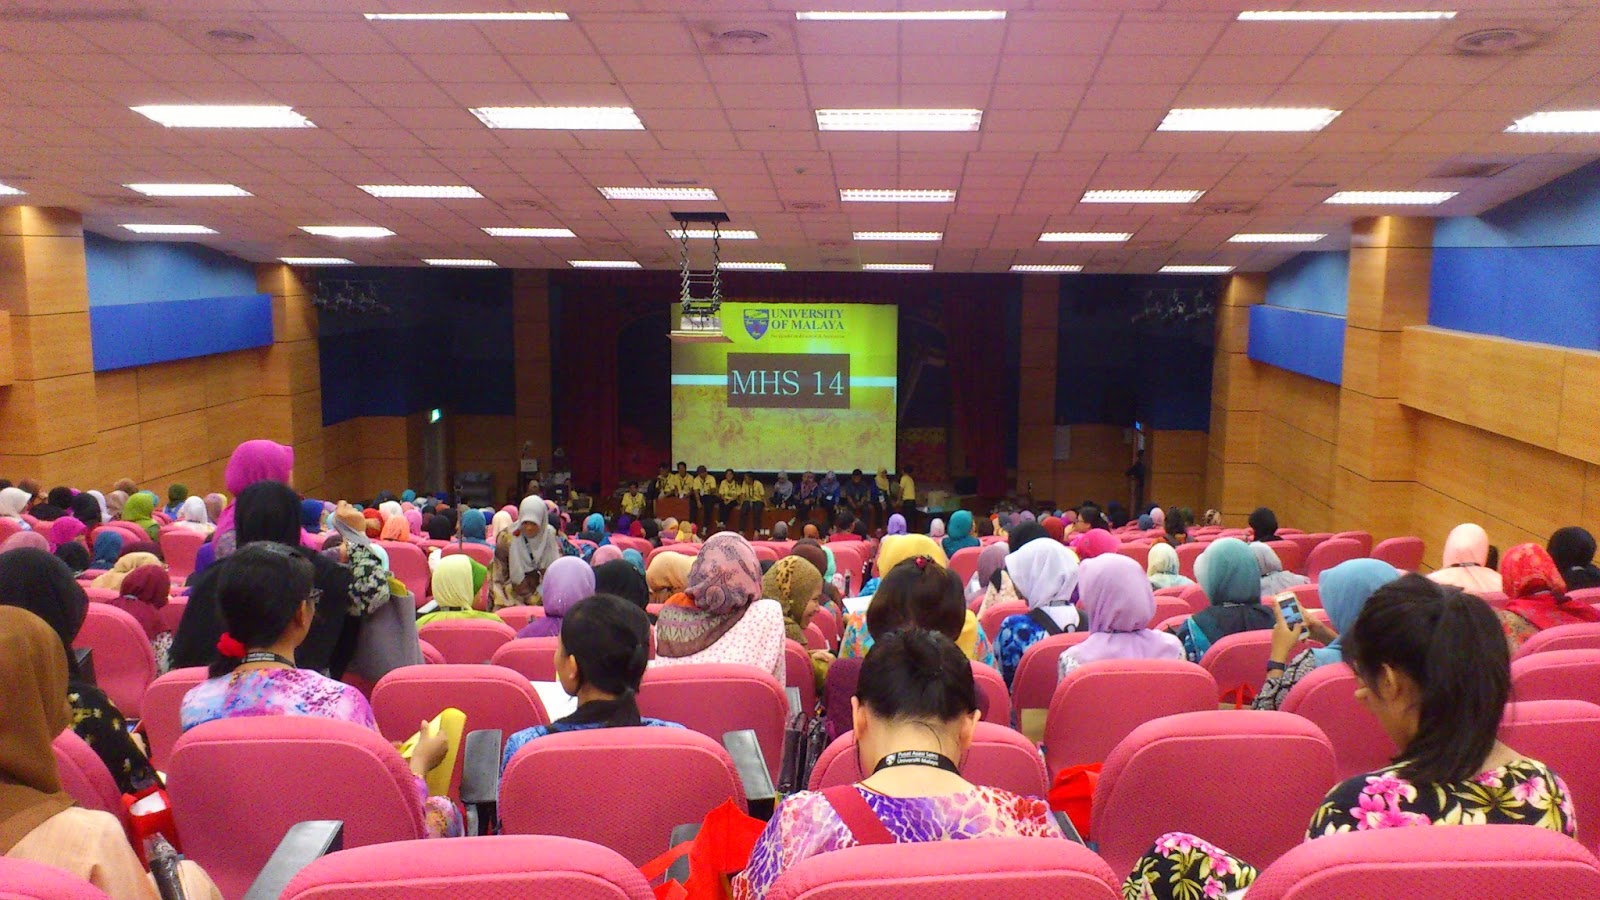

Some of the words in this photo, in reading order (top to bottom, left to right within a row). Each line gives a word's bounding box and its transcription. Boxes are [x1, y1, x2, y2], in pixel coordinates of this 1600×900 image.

[771, 308, 844, 319] UNIVERSITY
[771, 320, 788, 330] OF
[791, 320, 844, 330] MALAYA
[731, 370, 800, 395] MHS
[813, 370, 845, 396] 14
